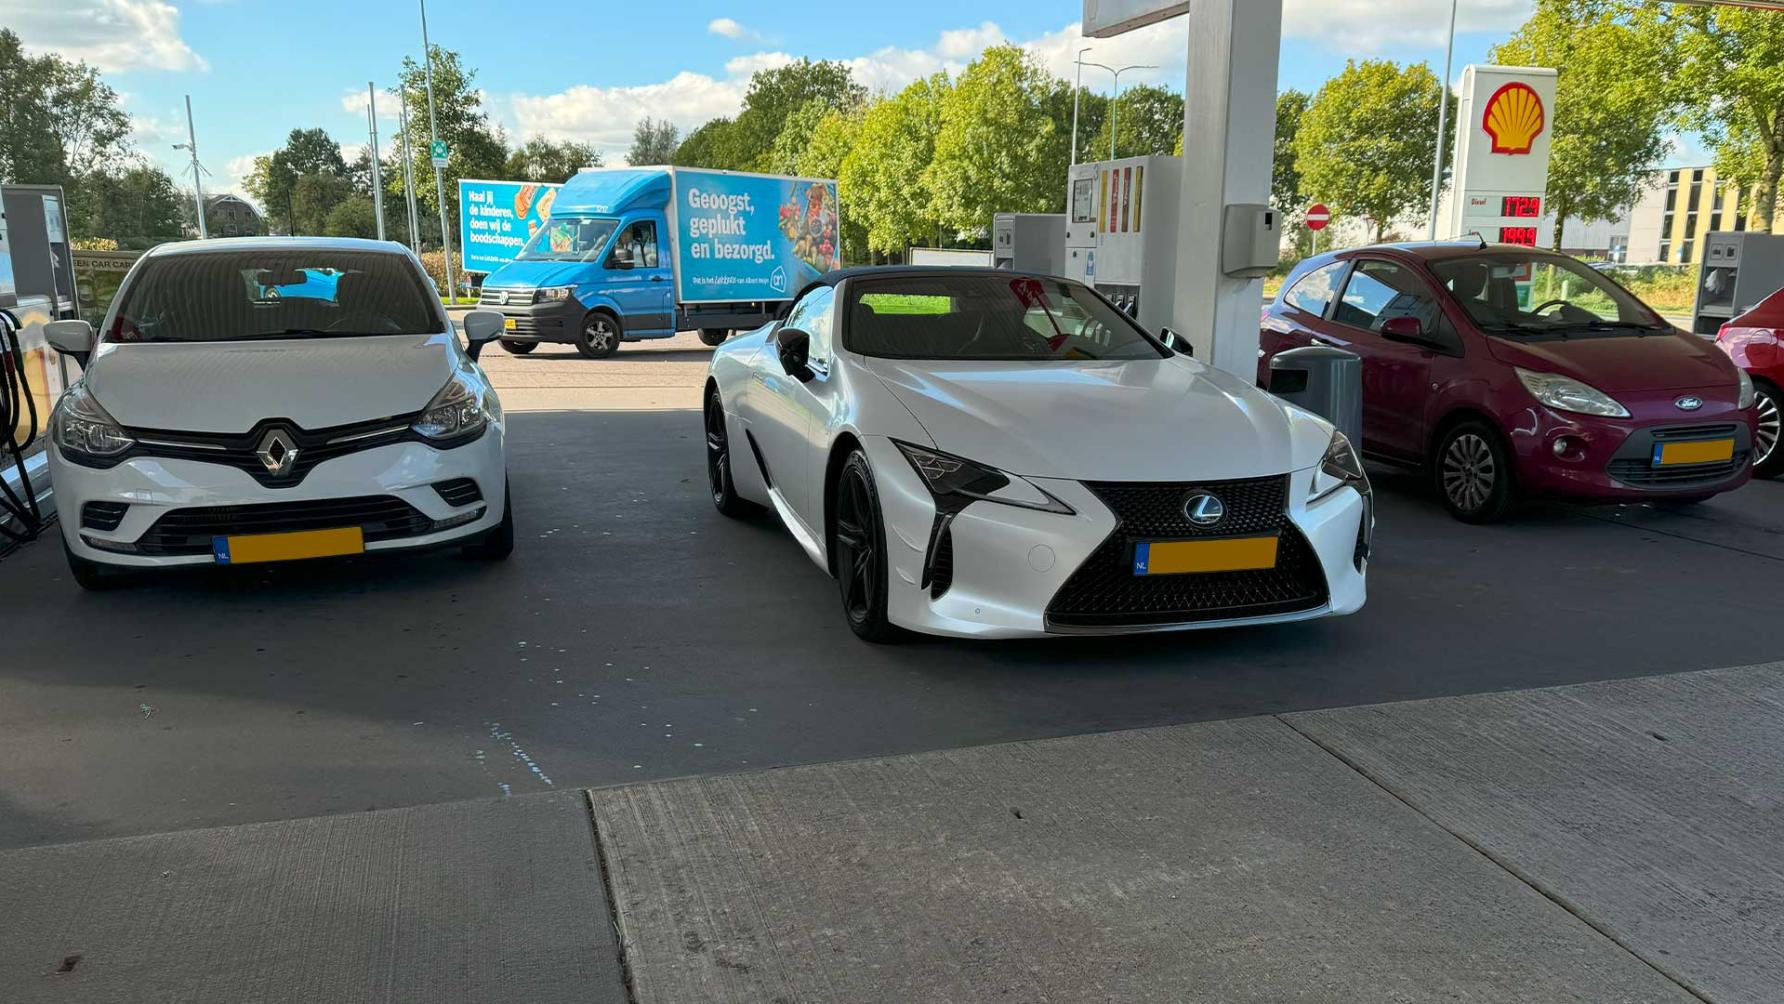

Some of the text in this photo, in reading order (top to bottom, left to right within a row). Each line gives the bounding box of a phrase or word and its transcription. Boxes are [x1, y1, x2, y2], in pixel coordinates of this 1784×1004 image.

[468, 190, 486, 202] Haal
[688, 188, 755, 216] Geoogst,
[469, 204, 514, 220] de kinderen,
[470, 217, 512, 233] doen wij de
[690, 213, 747, 238] geplukt
[691, 238, 775, 264] en bezorgd.
[217, 552, 229, 560] NL
[1136, 562, 1147, 570] NL
